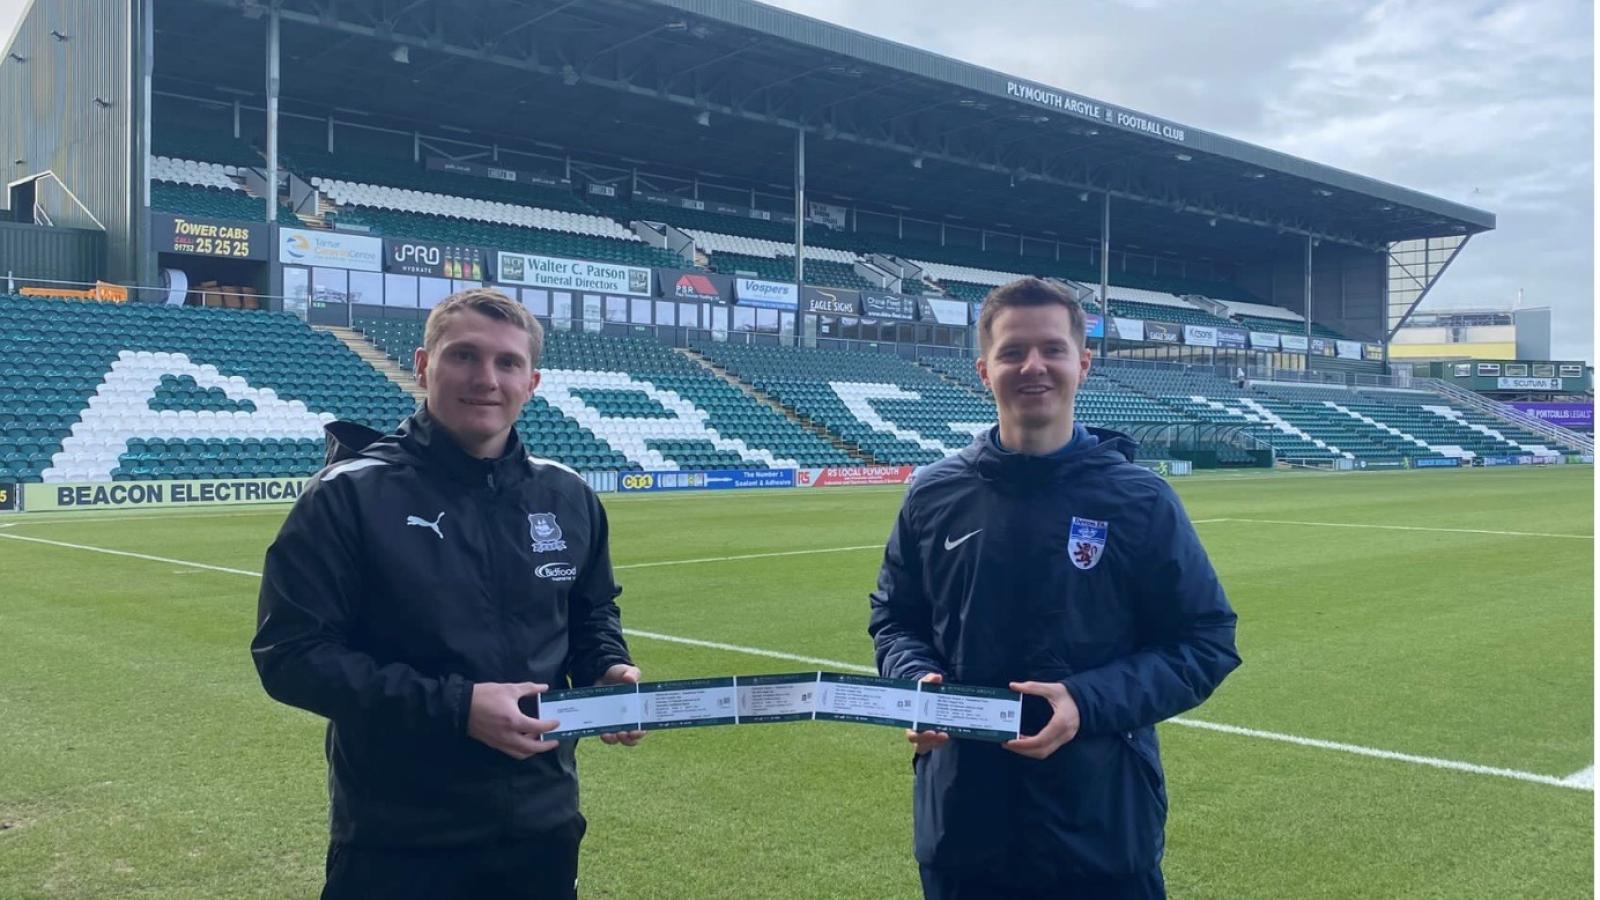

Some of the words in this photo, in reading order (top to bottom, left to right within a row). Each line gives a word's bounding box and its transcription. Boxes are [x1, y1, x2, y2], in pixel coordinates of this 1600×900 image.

[1007, 81, 1063, 108] PLYMOUTH
[1064, 99, 1101, 119] ARGYLE
[1117, 112, 1162, 136] FOOTBALL
[1161, 127, 1185, 142] CLUB
[174, 218, 218, 237] TOWER
[219, 226, 249, 240] CABS
[196, 238, 213, 253] 25
[215, 240, 231, 255] 25
[233, 241, 249, 257] 25
[528, 258, 568, 274] Walter
[571, 263, 583, 275] C.
[586, 265, 626, 280] Parson
[535, 272, 573, 286] Funeral
[575, 276, 618, 290] Directors
[745, 280, 790, 296] Vospers
[810, 299, 832, 312] EAGLE
[1535, 409, 1569, 419] PORTCULLIS
[838, 467, 862, 477] LOCAL
[863, 466, 899, 476] PLYMOUTH
[765, 478, 791, 487] Adhesive
[57, 485, 163, 506] BEACON
